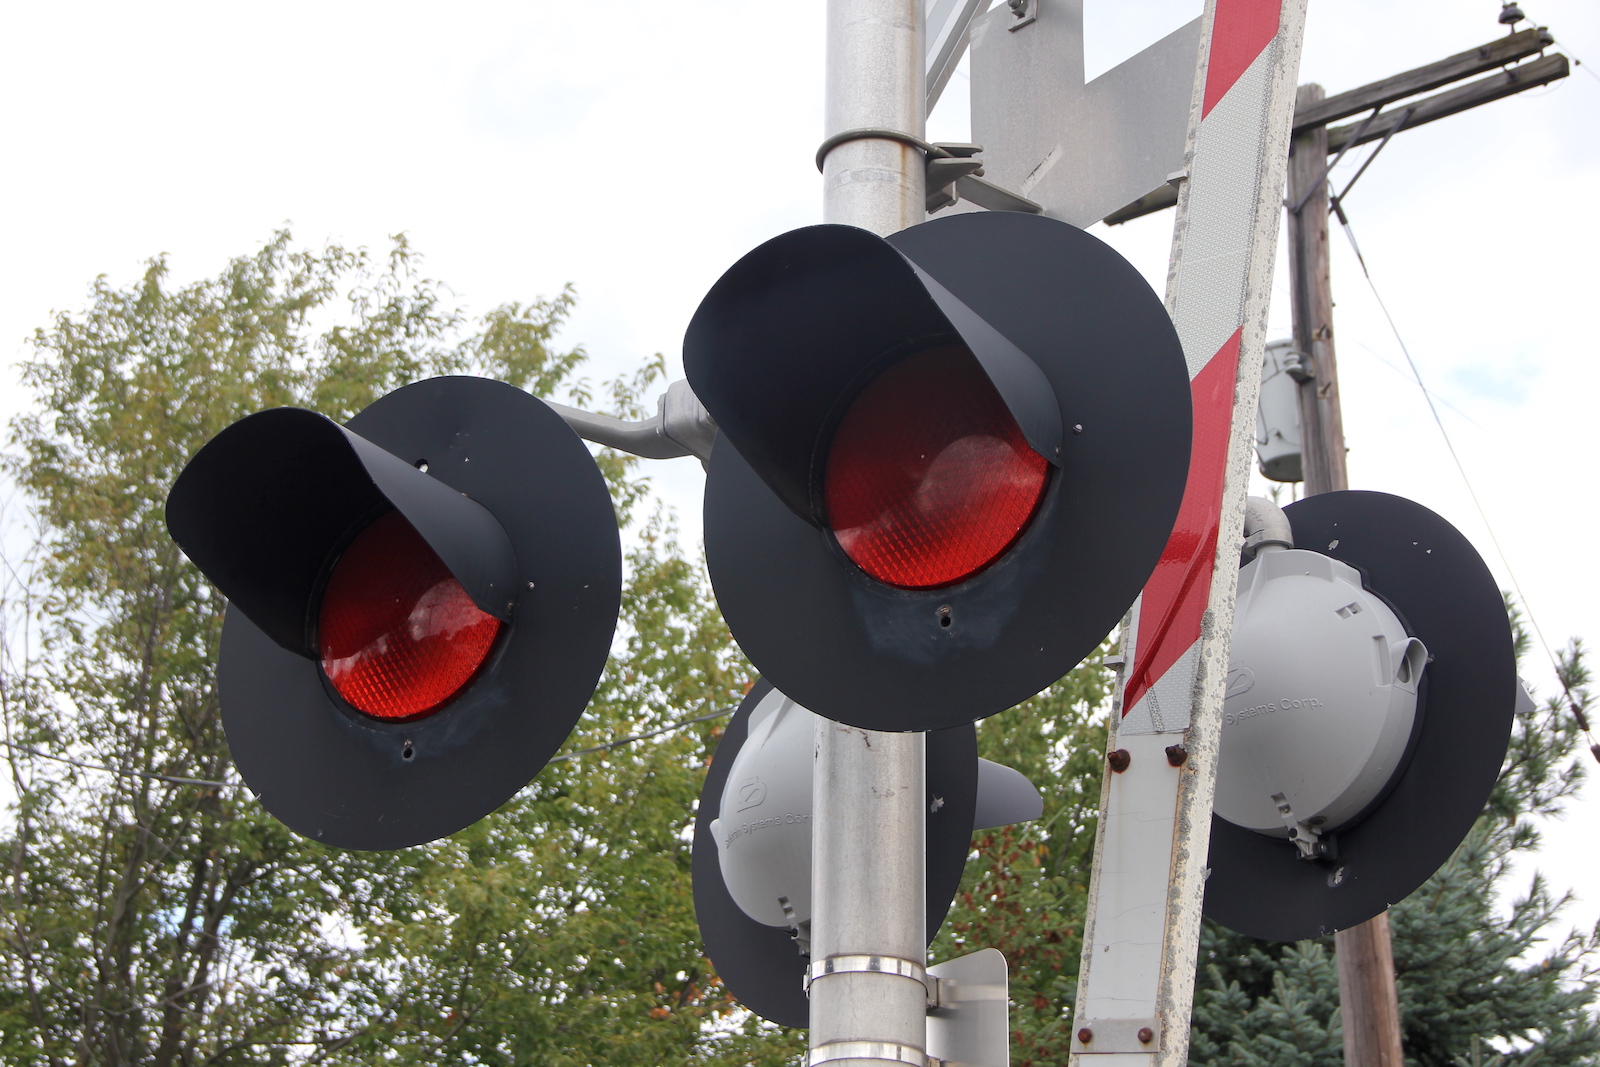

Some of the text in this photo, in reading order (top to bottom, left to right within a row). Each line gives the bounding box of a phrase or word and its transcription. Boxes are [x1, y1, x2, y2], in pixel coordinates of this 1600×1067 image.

[1225, 697, 1324, 725] Systems Corp.
[742, 815, 782, 835] Systems
[784, 812, 813, 824] Cor
